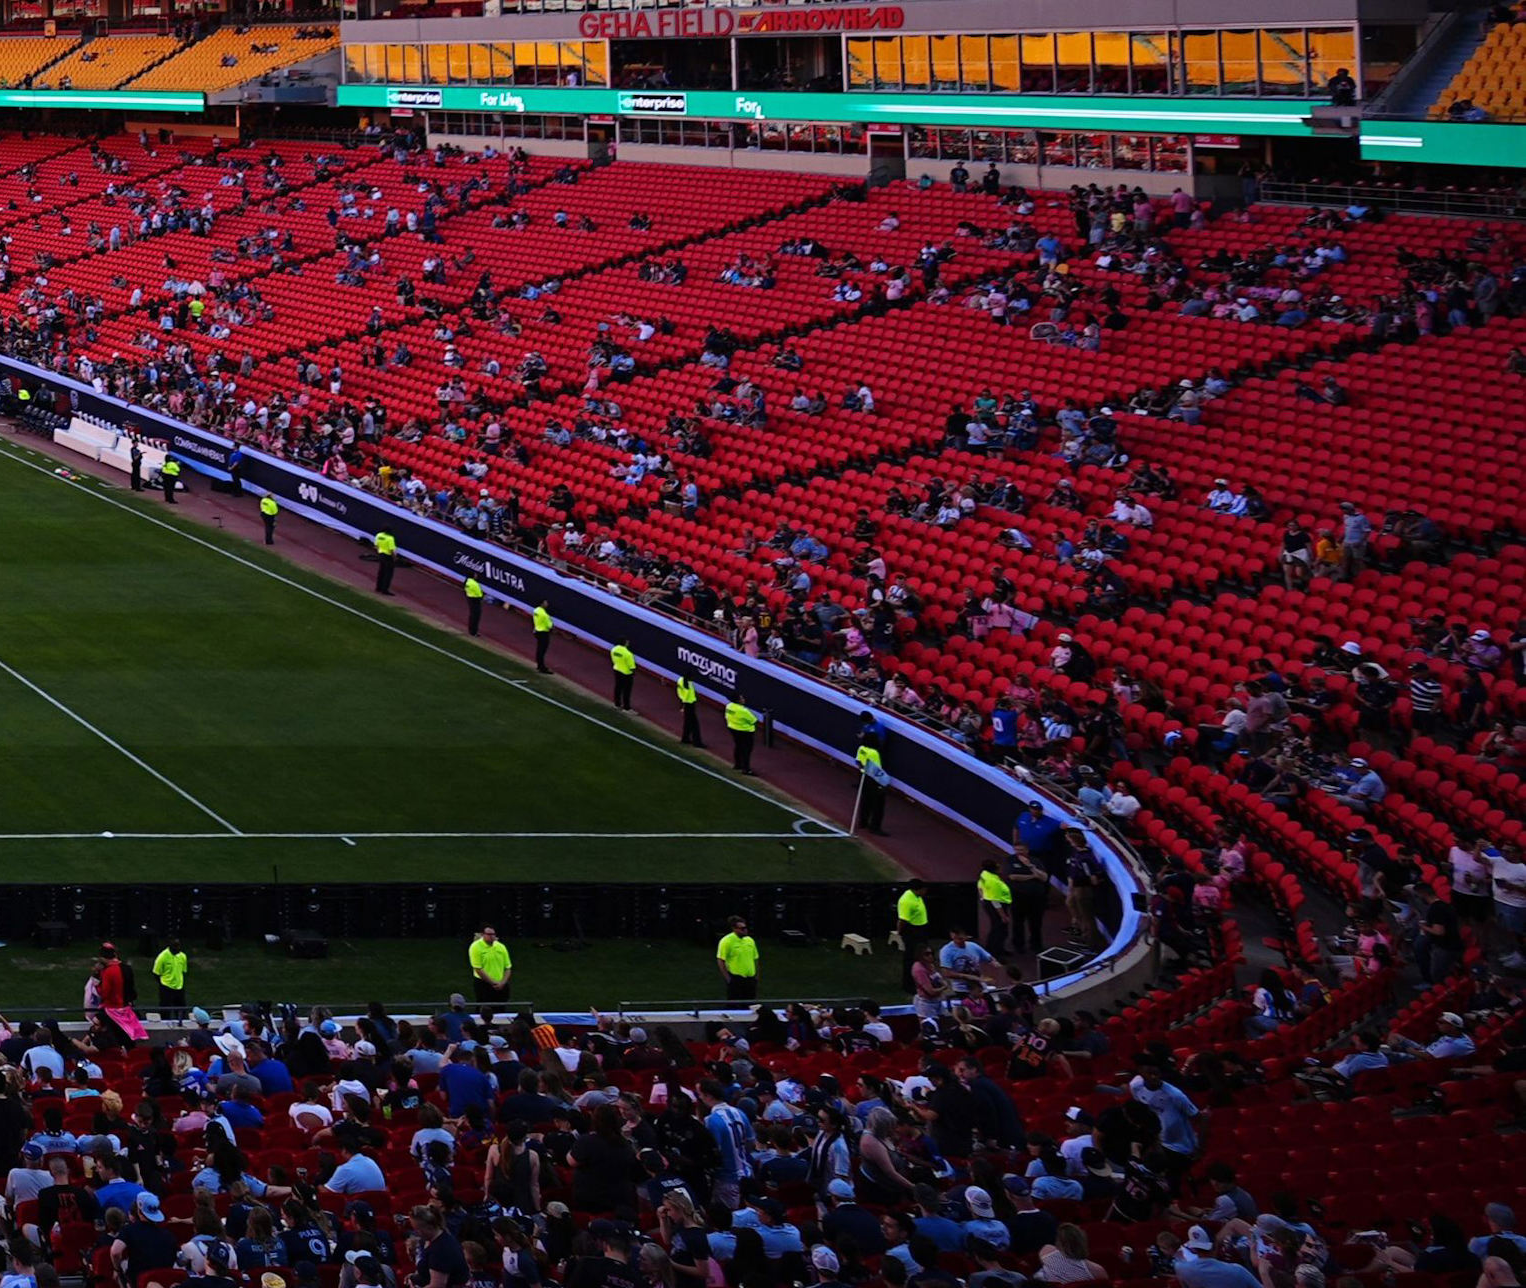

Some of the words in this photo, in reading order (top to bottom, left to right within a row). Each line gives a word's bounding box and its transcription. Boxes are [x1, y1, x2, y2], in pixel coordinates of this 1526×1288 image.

[579, 10, 652, 38] GEHA
[658, 8, 734, 37] FIELD
[753, 7, 905, 32] ARROWHEAD
[388, 91, 440, 106] enterprise
[480, 92, 498, 106] For
[621, 95, 685, 112] enterprise
[736, 97, 755, 113] For
[453, 551, 484, 573] Michelob
[492, 567, 525, 592] ULTRA
[677, 646, 737, 683] mazuma
